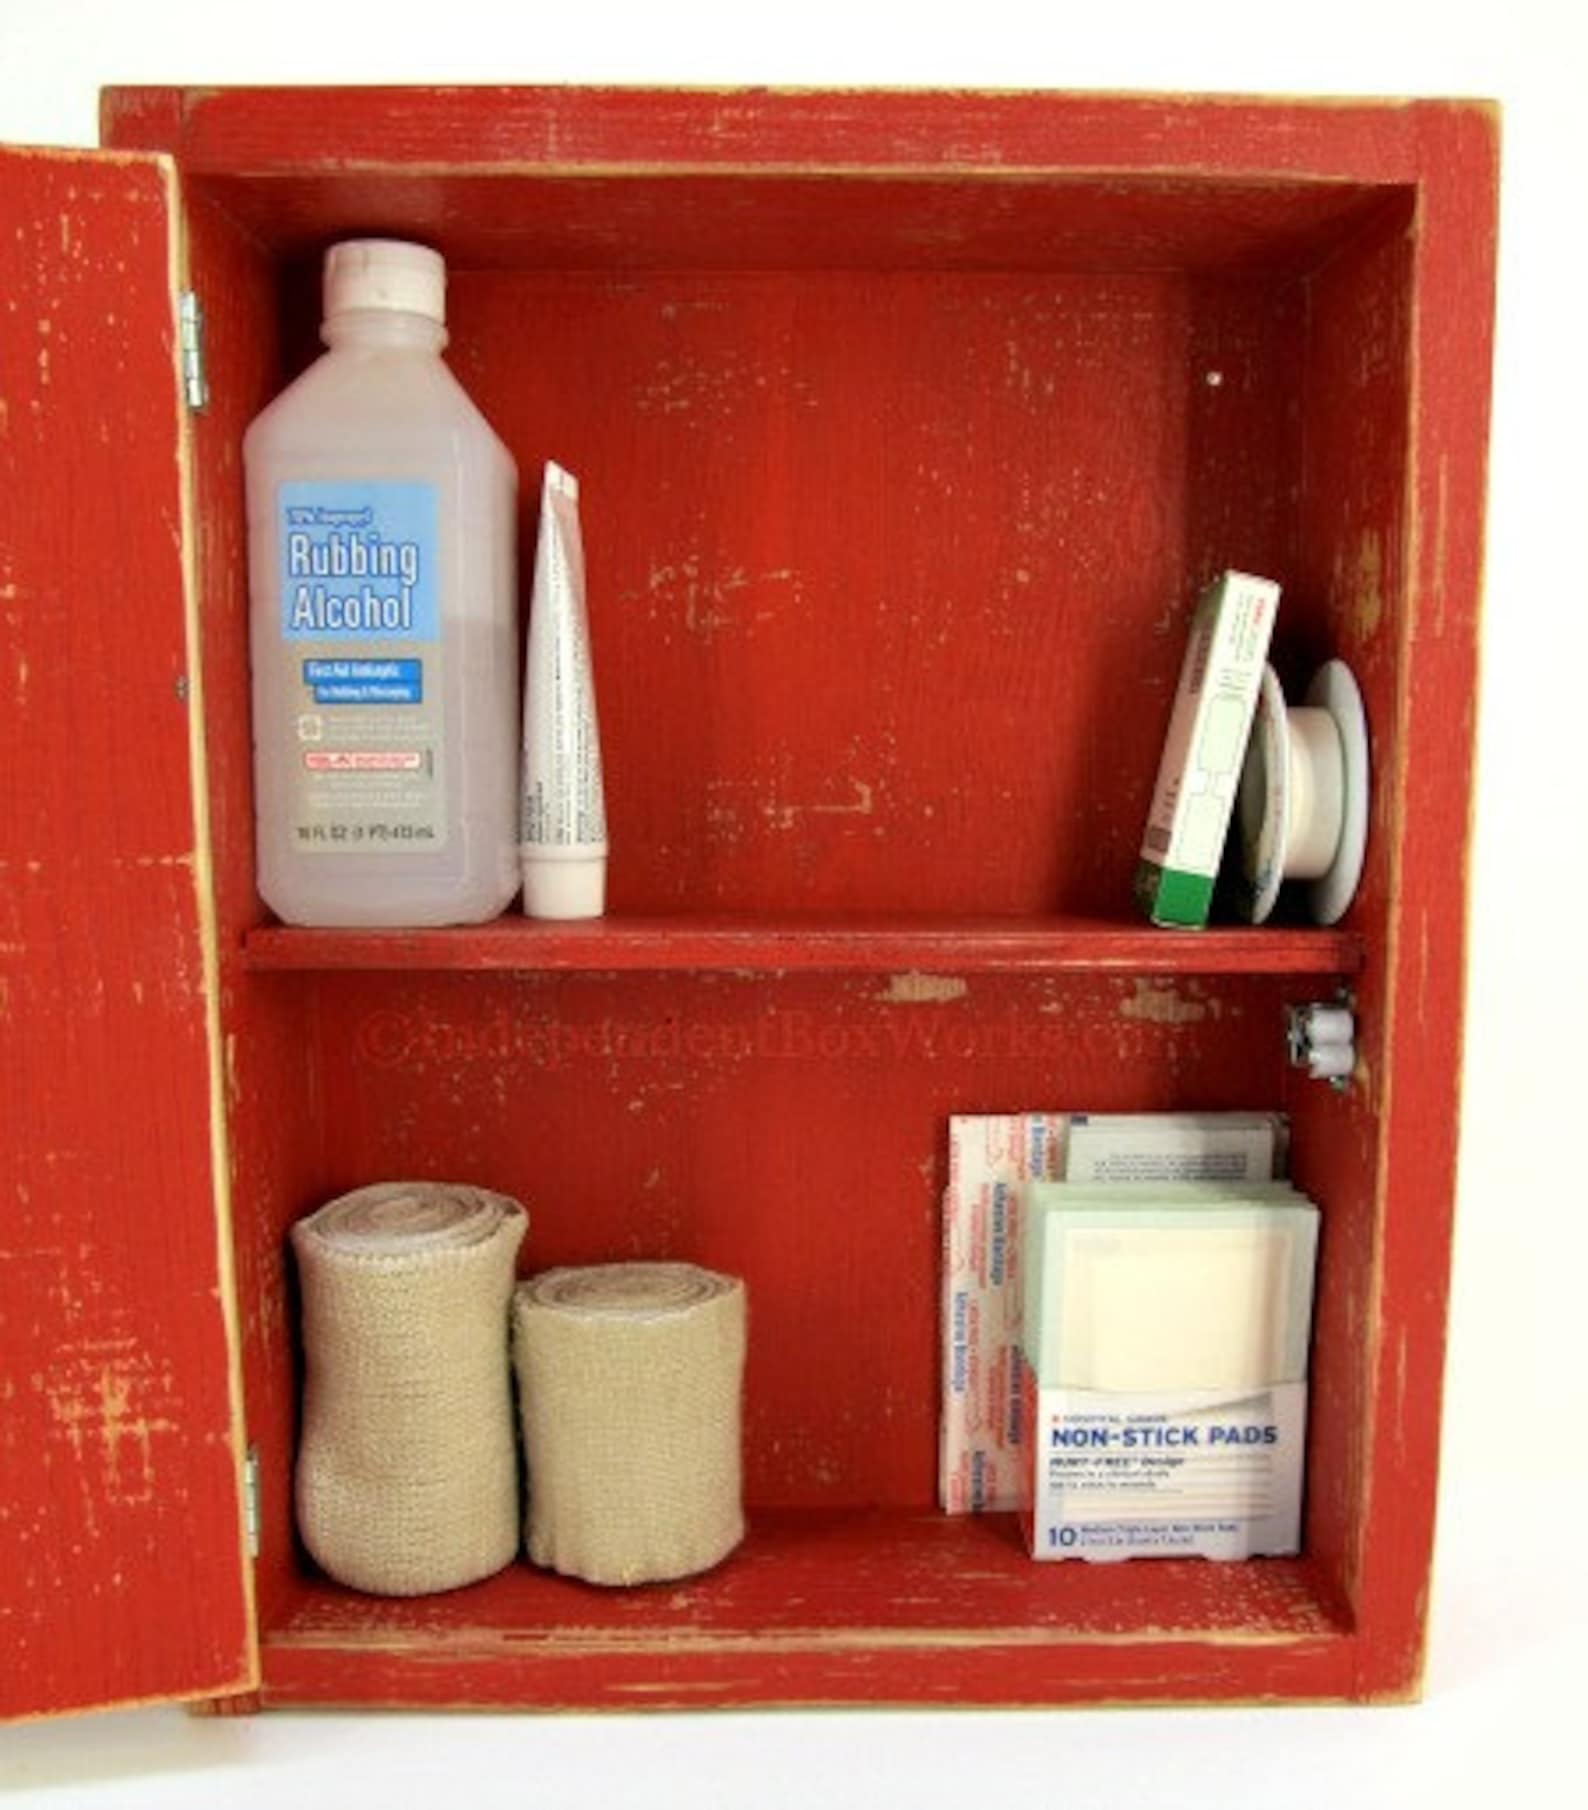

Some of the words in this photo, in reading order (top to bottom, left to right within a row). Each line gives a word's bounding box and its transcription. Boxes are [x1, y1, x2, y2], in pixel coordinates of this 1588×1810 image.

[289, 532, 419, 586] Rubbing
[291, 584, 412, 630] Alcohol
[1051, 1426, 1198, 1448] NON-STICK
[1208, 1426, 1278, 1445] PADS
[1049, 1527, 1077, 1547] 10
